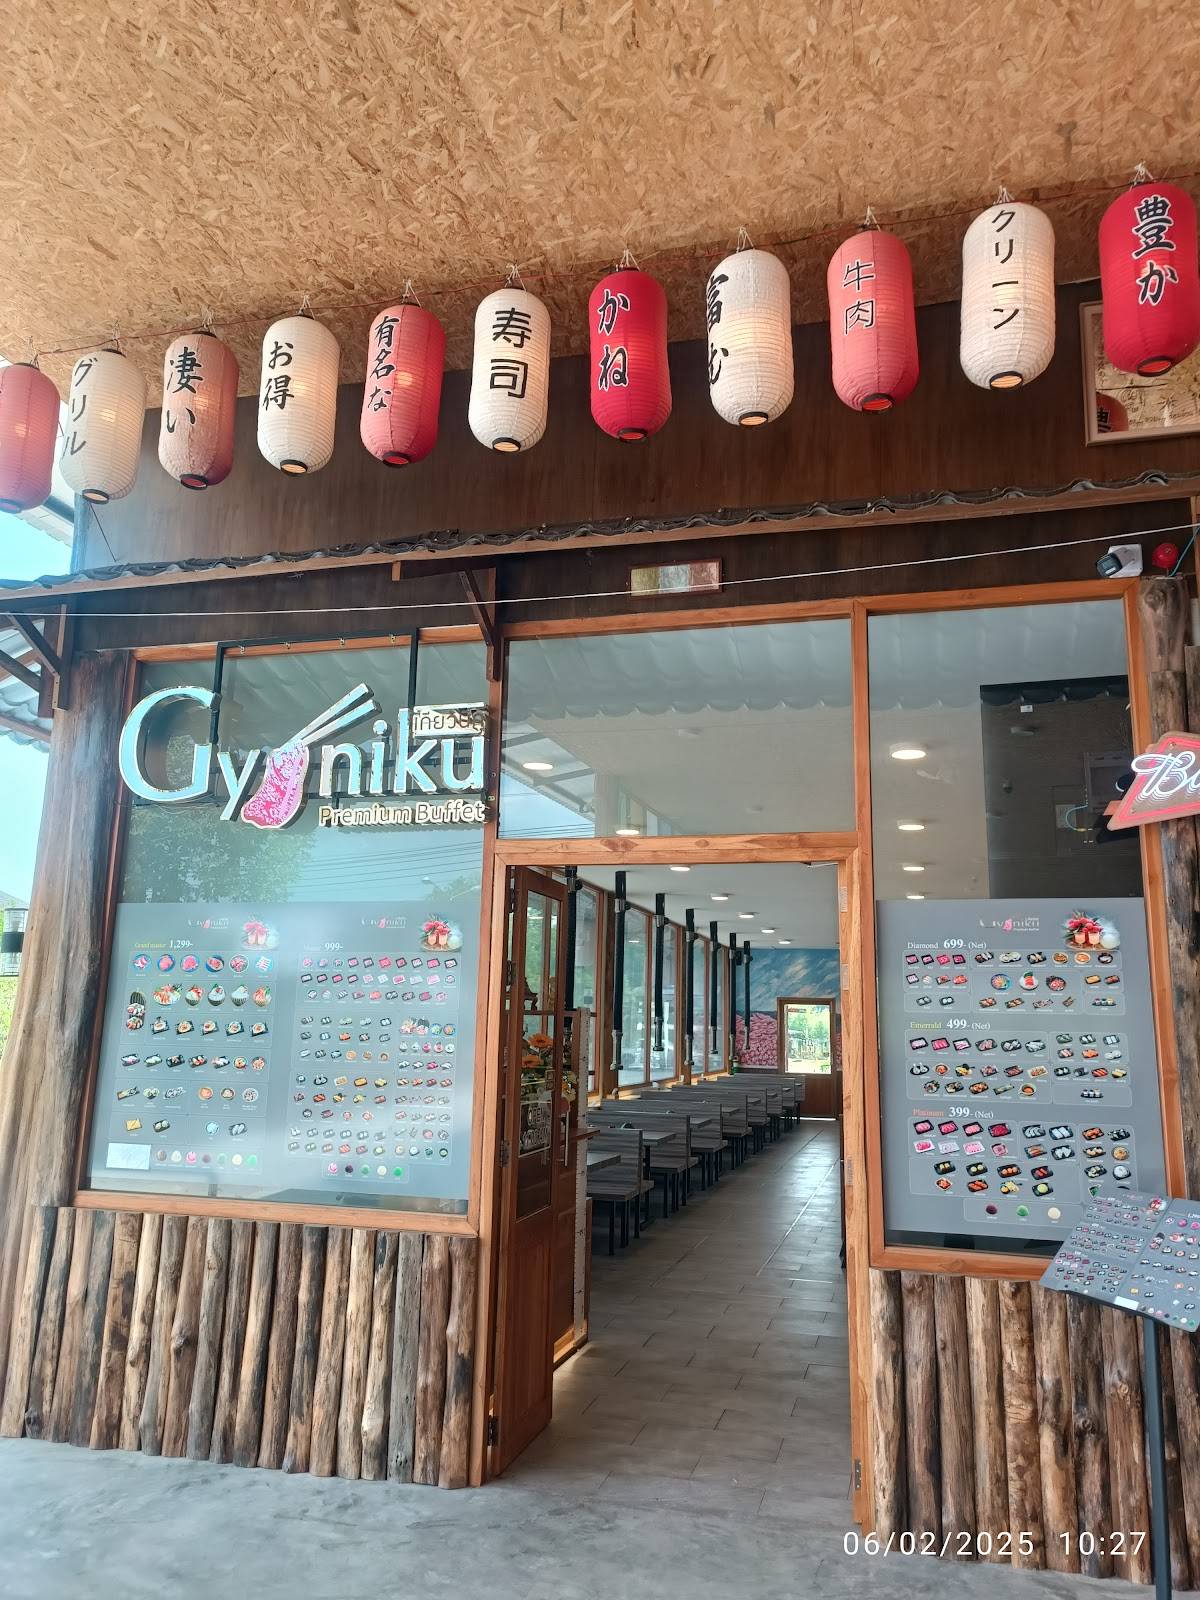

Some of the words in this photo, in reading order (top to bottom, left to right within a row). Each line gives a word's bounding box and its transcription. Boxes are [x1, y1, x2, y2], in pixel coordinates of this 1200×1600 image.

[992, 210, 1020, 330] クリーン
[1132, 194, 1179, 305] 豊か
[843, 259, 875, 336] 牛肉
[263, 340, 295, 411] お得
[367, 314, 400, 413] 有名な
[490, 307, 532, 399] 寿司
[598, 289, 631, 392] かね
[62, 357, 98, 460] グリル
[319, 802, 412, 826] Premium
[415, 799, 486, 824] Buffet
[907, 941, 939, 950] Diamond
[968, 941, 987, 950] (Net)
[971, 1021, 991, 1030] (Net)
[974, 1110, 994, 1119] (Net)
